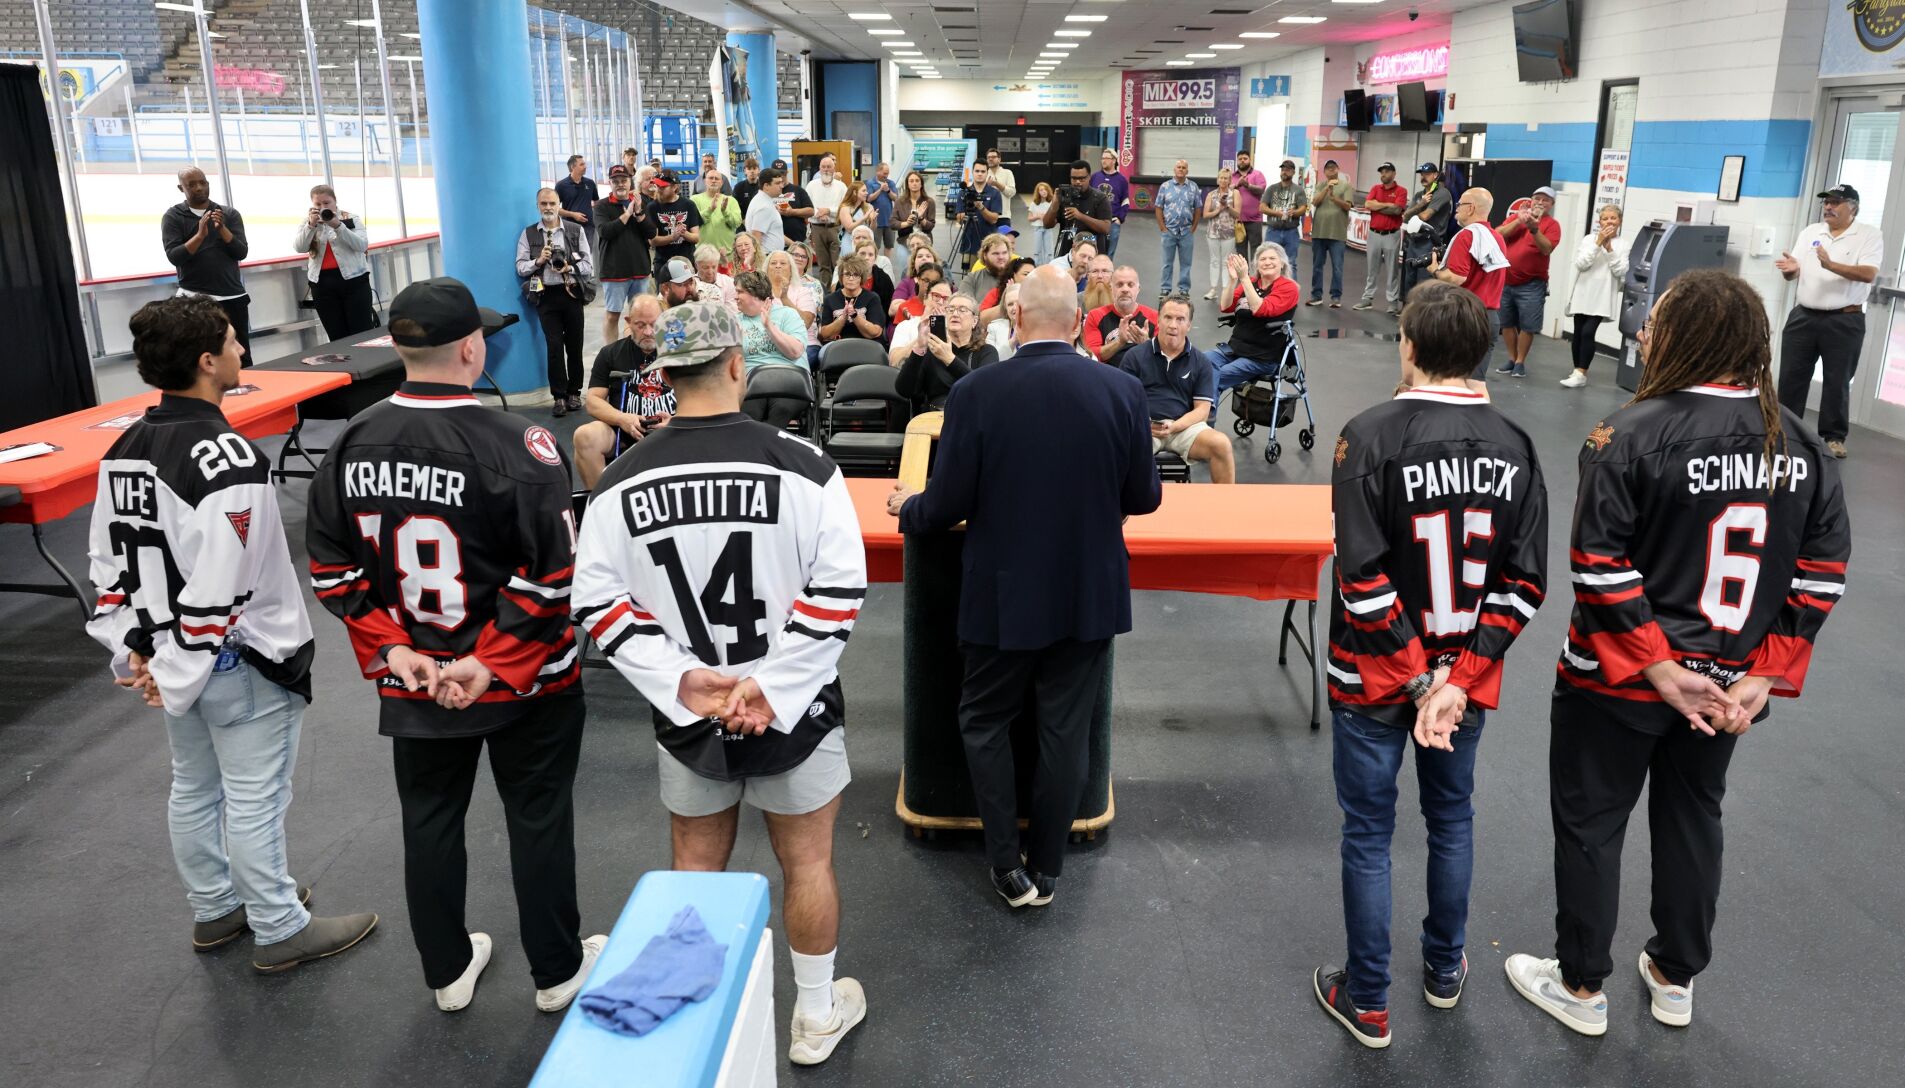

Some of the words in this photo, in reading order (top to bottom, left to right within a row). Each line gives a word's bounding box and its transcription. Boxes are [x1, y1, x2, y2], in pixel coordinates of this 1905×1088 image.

[1145, 83, 1177, 101] MIX
[1178, 82, 1215, 100] 99.5
[101, 119, 117, 128] 121
[338, 122, 357, 130] 121
[1139, 116, 1173, 125] SKATE
[1175, 116, 1219, 125] RENTAL
[627, 392, 639, 415] NO
[190, 433, 257, 481] 20
[1687, 453, 1808, 495] SCHNAPP
[345, 461, 465, 507] KRAEMER
[629, 478, 769, 530] BUTTITTA
[354, 512, 470, 632] 8
[1698, 502, 1768, 635] 6
[646, 530, 770, 667] 14
